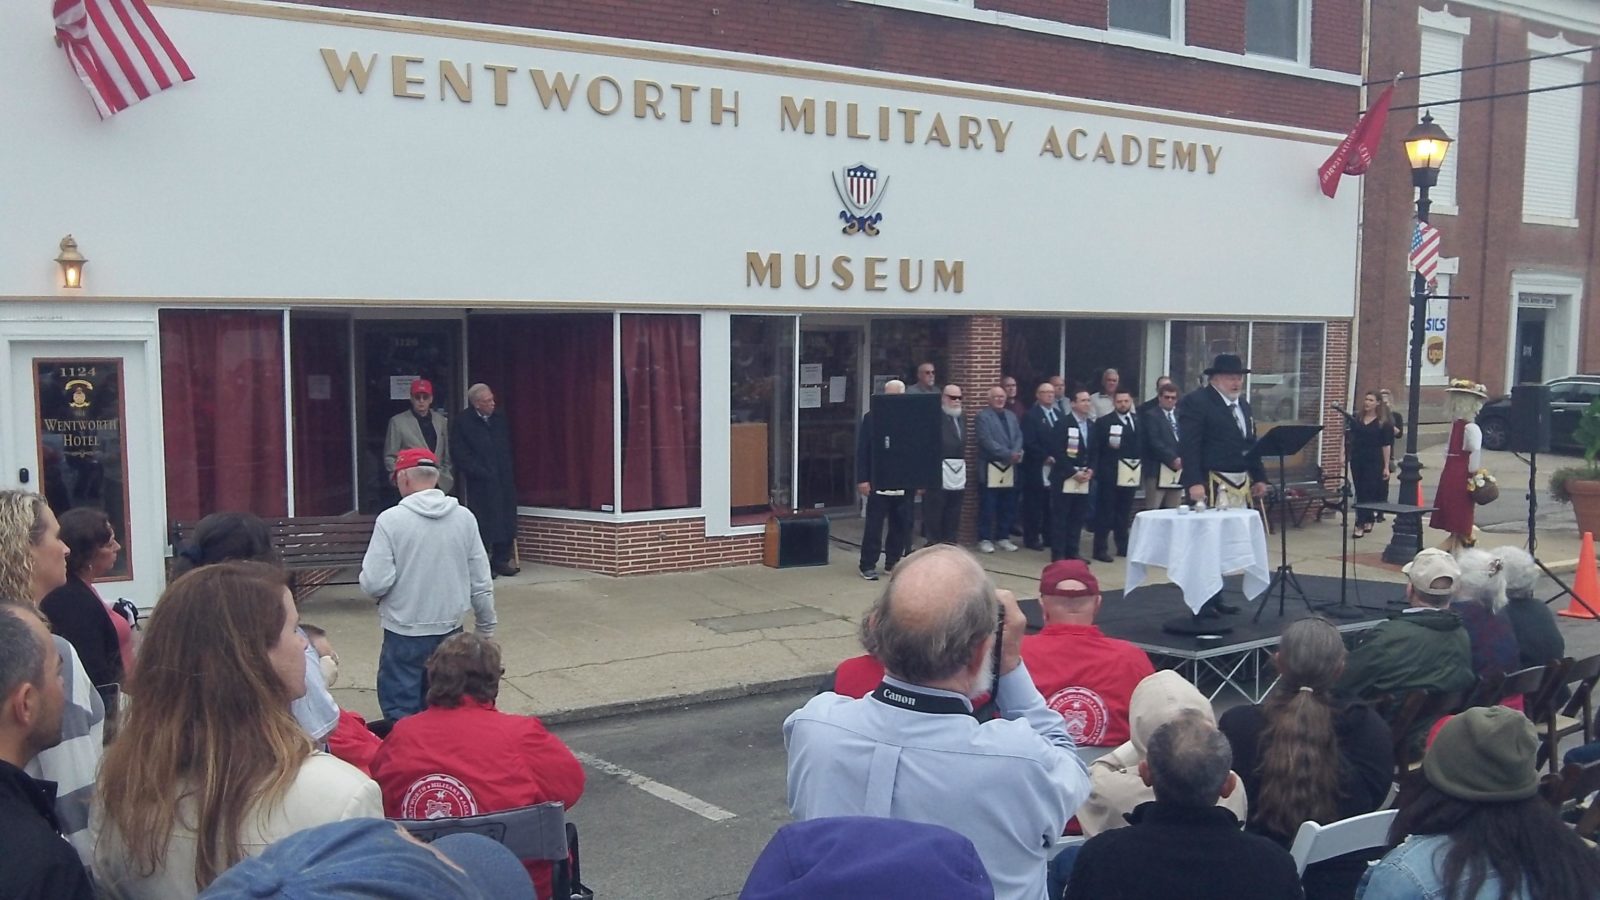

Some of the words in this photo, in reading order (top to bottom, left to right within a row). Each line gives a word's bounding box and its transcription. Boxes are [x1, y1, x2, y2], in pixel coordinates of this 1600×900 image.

[319, 47, 740, 128] WENTWORTH
[779, 95, 1014, 153] MILITARY
[1039, 125, 1223, 175] ACADEMY
[745, 251, 965, 294] MUSEUM
[59, 367, 97, 377] 1124
[44, 418, 119, 432] WENTWORTH
[63, 433, 100, 447] HOTEL
[883, 688, 916, 706] Canon
